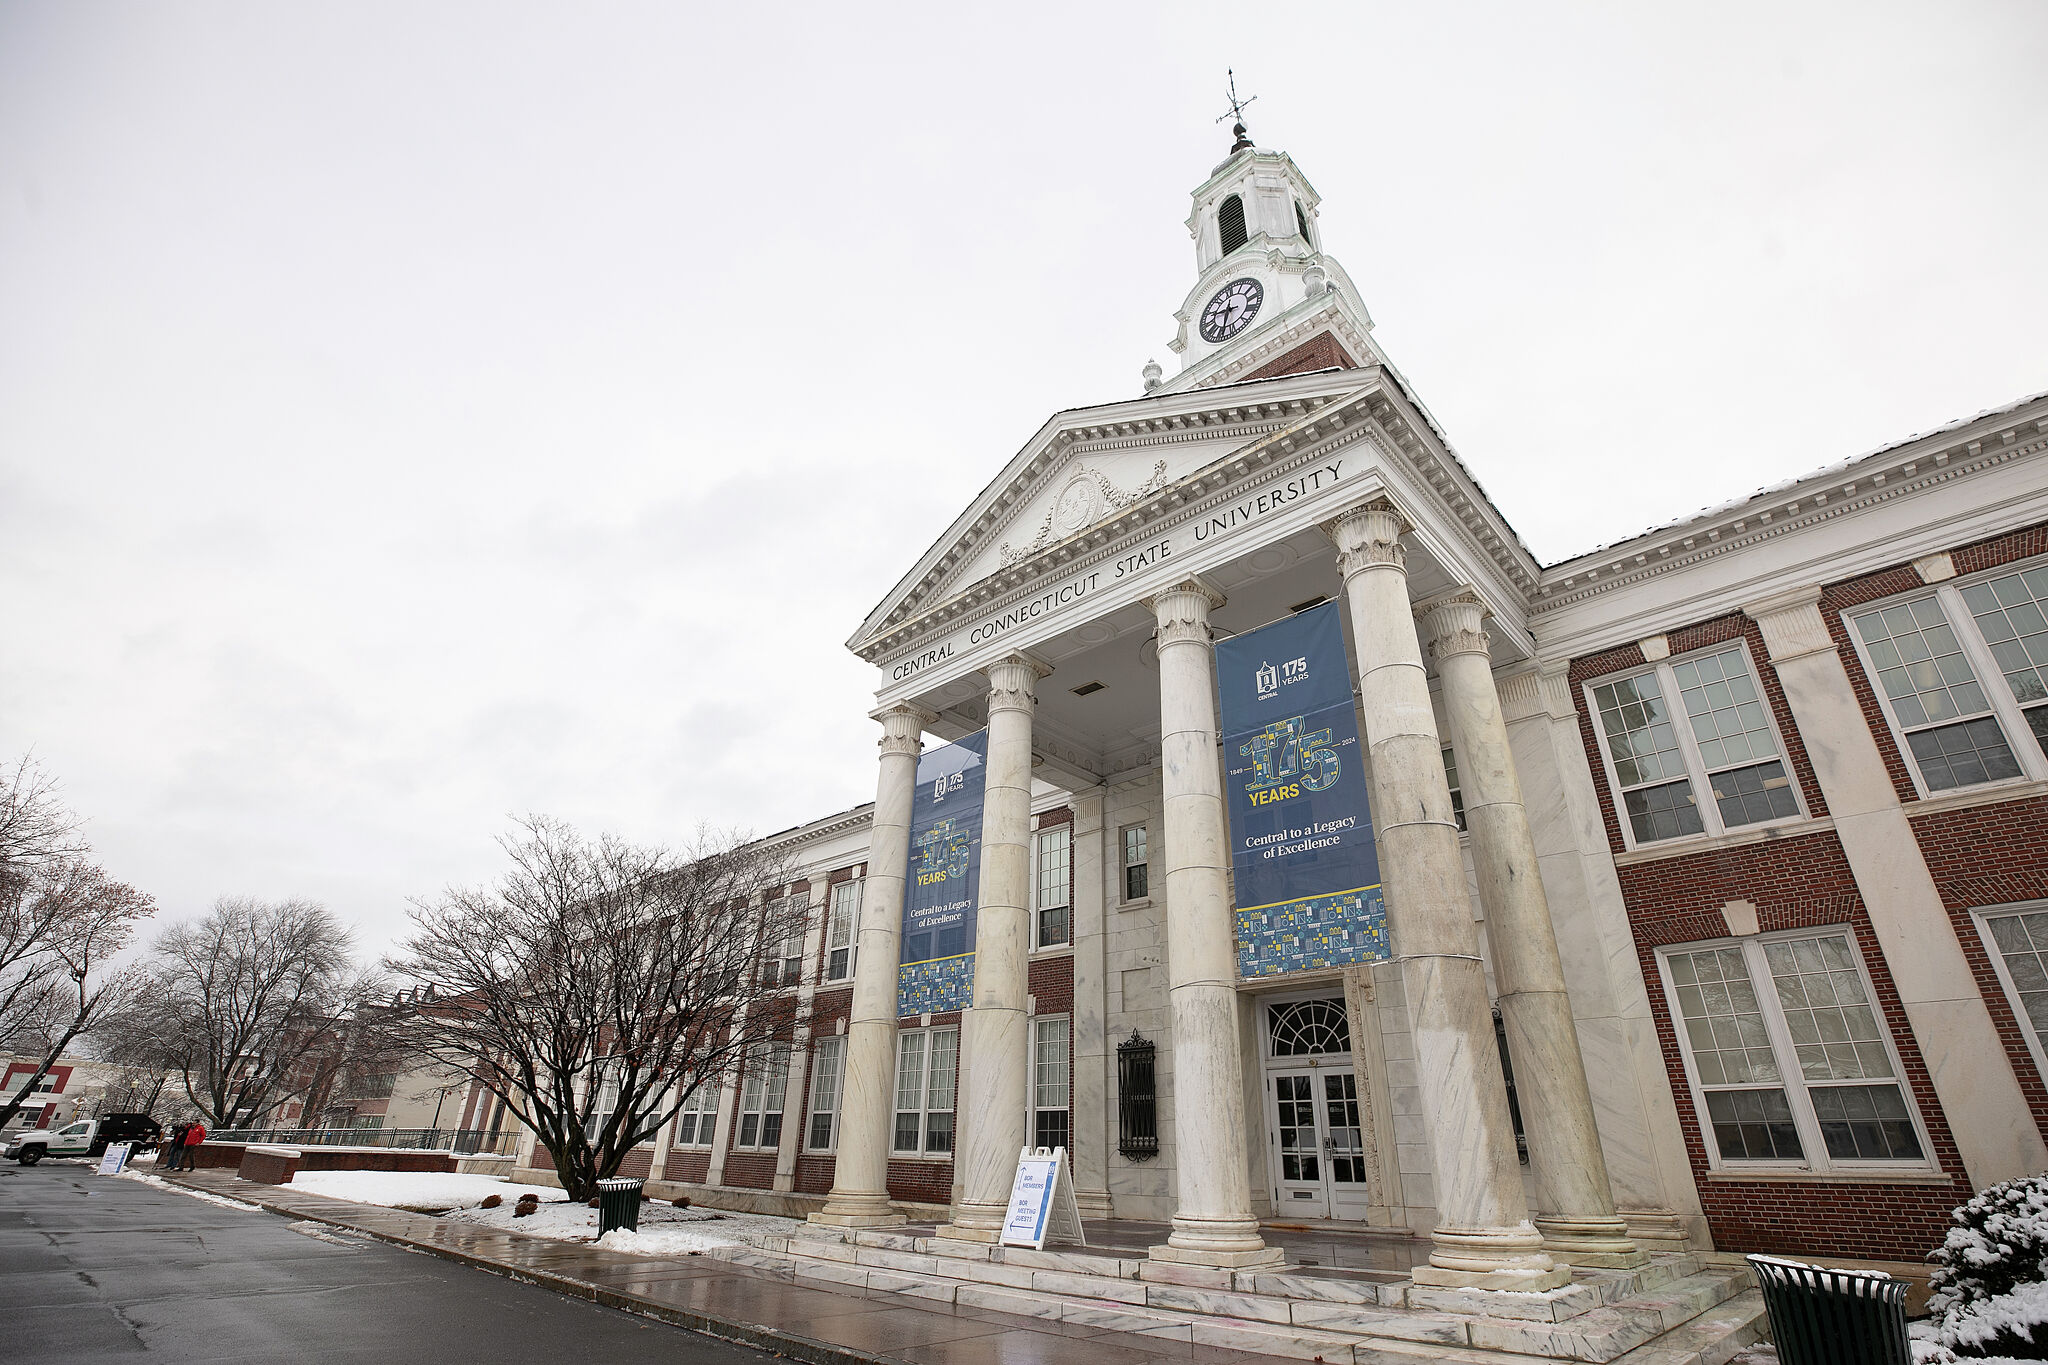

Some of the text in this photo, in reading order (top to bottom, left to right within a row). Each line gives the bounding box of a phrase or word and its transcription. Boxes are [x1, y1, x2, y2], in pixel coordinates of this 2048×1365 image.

[893, 460, 1343, 681] CENTRAL CONNECTICUT STATE UNIVERSITY
[1282, 656, 1307, 677] 175
[1281, 671, 1310, 686] YEARS
[1240, 715, 1341, 792] 175
[1248, 783, 1300, 807] YEARS
[1245, 815, 1357, 848] Central to a Legacy
[1263, 835, 1341, 859] of Excellence
[918, 870, 947, 886] YEARS
[910, 905, 935, 918] Central
[935, 905, 942, 913] to
[948, 899, 972, 911] Legacy
[918, 912, 962, 928] of Excellence
